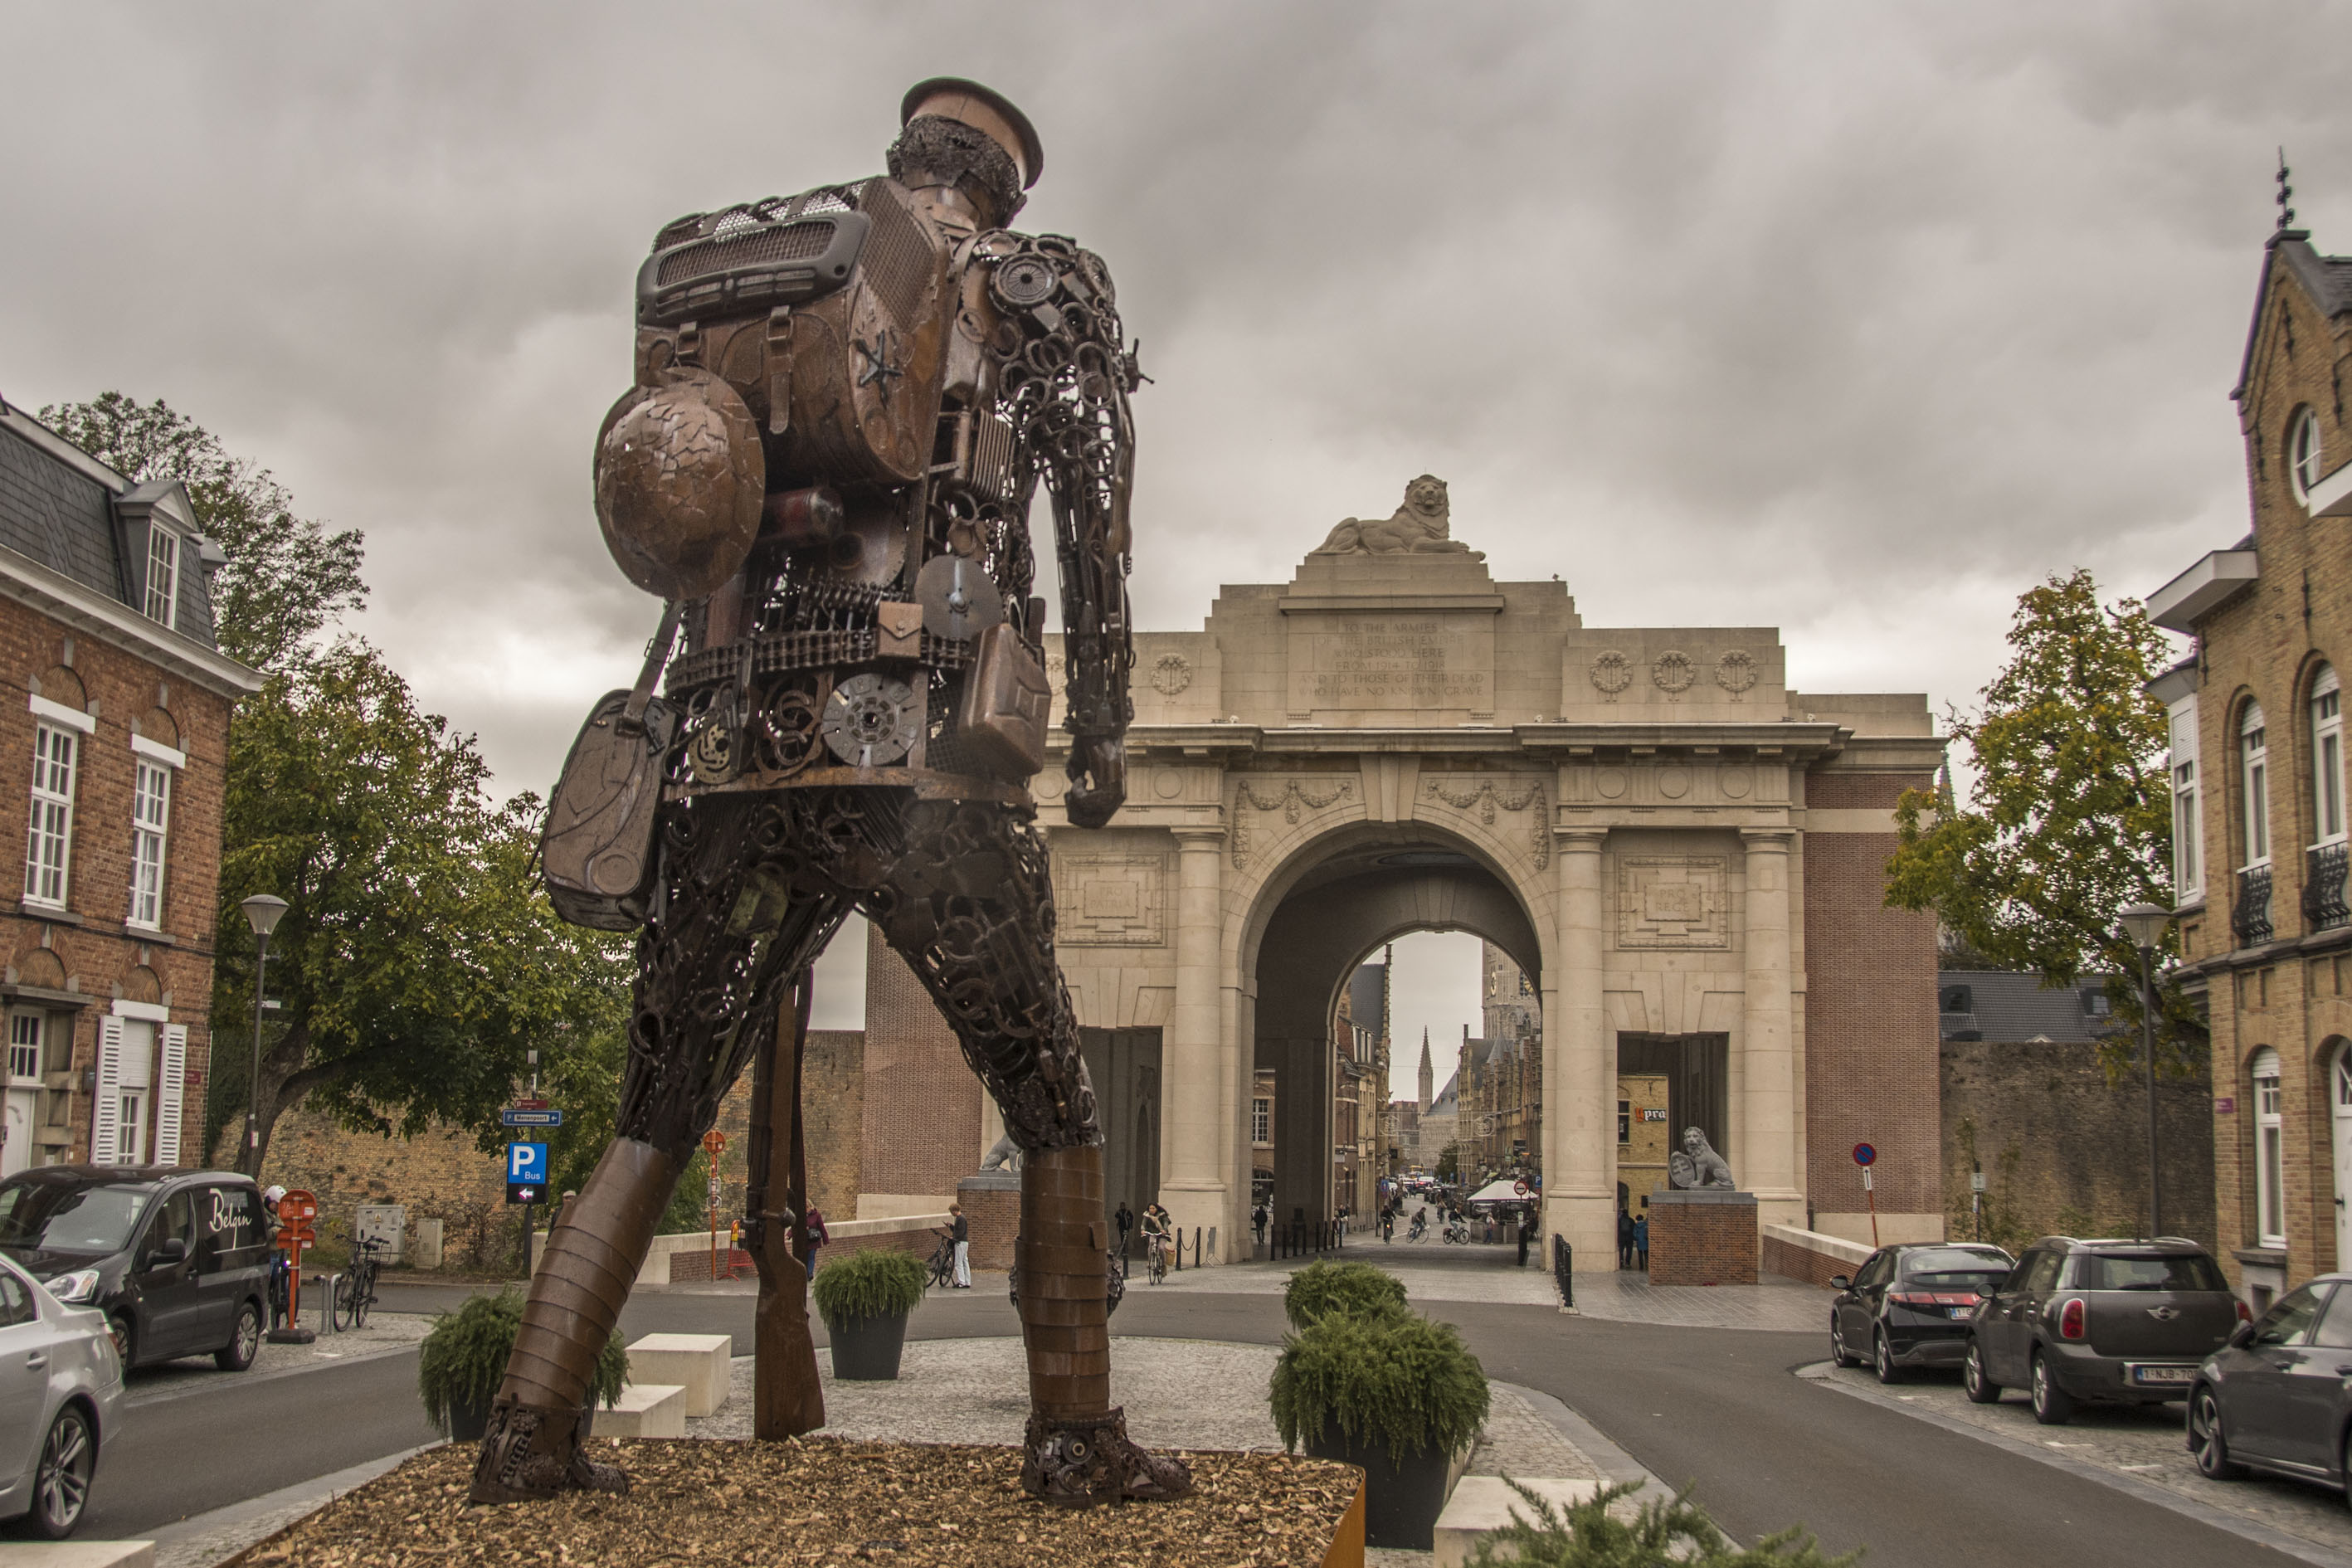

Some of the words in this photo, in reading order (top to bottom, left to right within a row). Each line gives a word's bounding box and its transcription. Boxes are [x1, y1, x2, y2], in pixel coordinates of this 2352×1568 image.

[1344, 623, 1359, 632] TO
[1364, 623, 1386, 632] THE
[1394, 623, 1438, 632] ARMIES
[1317, 635, 1332, 645] OF
[1339, 635, 1361, 645] THE
[1366, 635, 1414, 645] BRITISH
[1420, 635, 1463, 645] EMPIRE
[1334, 649, 1361, 658] WHO
[1366, 649, 1405, 658] STOOD
[1412, 648, 1444, 658] HERE
[1336, 661, 1371, 670] FROM
[1376, 661, 1400, 670] 1914
[1405, 661, 1419, 670] TO
[1424, 660, 1444, 670] 1918
[1299, 674, 1327, 684] AND
[1333, 674, 1346, 684] TO
[1353, 674, 1389, 684] THOSE
[1395, 674, 1410, 683] OF
[1413, 673, 1448, 683] THEIR
[1452, 674, 1483, 683] DEAD
[1299, 687, 1327, 696] WHO
[1331, 687, 1361, 696] HAVE
[1367, 686, 1385, 696] NO
[1390, 686, 1436, 696] KNOWN
[1444, 686, 1483, 696] GRAVE
[1100, 887, 1122, 896] PRO
[1659, 889, 1686, 898] PRO
[1656, 902, 1689, 912] REGE
[513, 1146, 535, 1175] P
[524, 1171, 541, 1180] Bus
